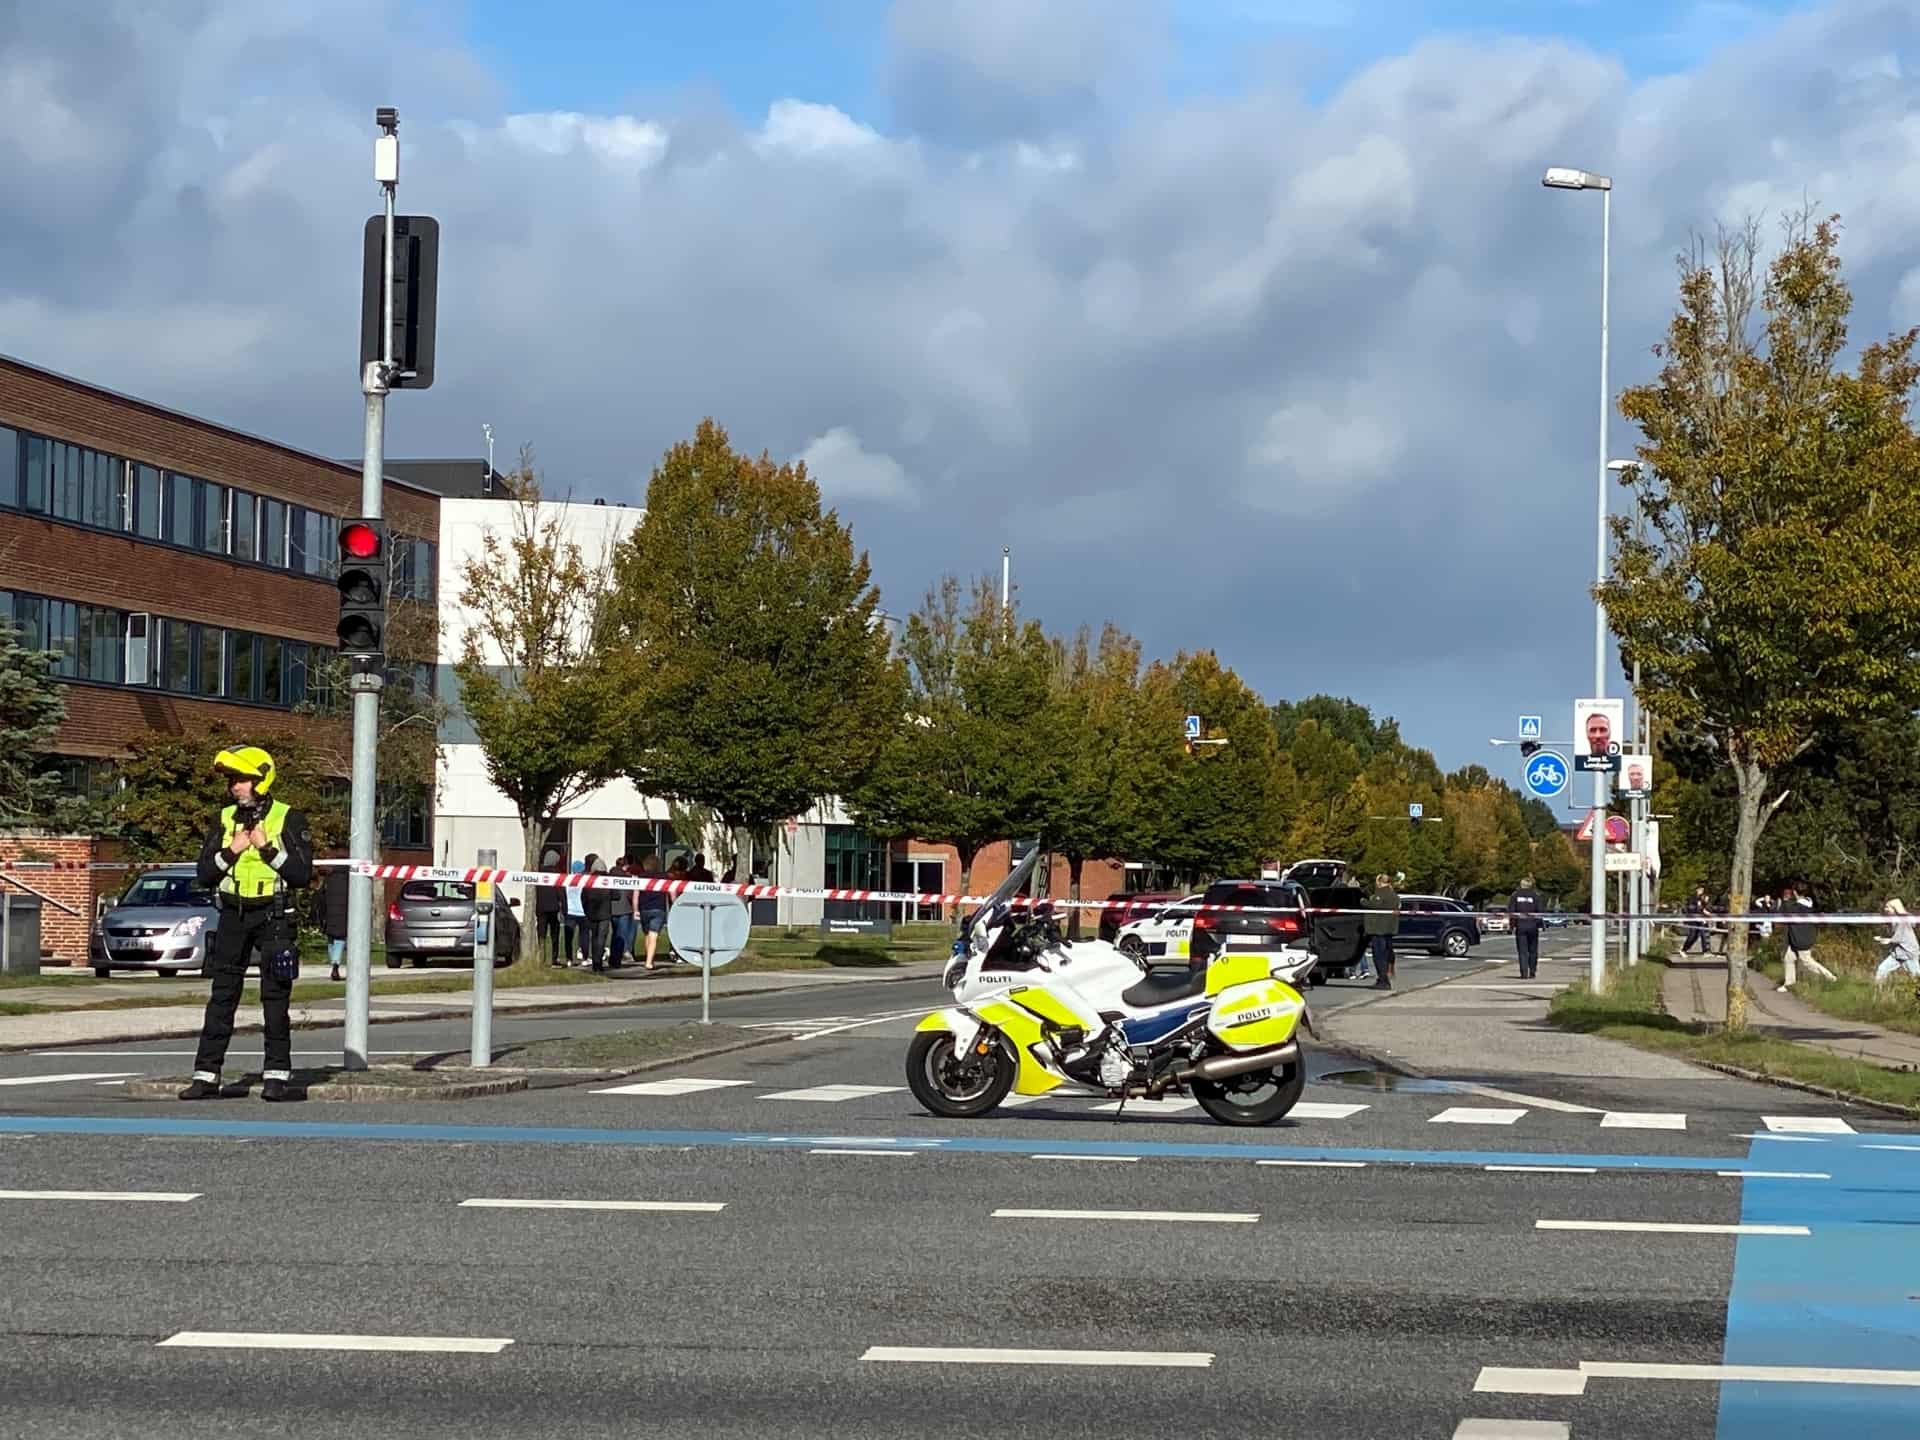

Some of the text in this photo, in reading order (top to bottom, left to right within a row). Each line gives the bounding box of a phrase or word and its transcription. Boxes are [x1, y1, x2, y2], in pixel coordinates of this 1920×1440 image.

[432, 869, 459, 877] POLITI
[512, 875, 539, 883] POLITI
[613, 878, 640, 886] POLITI
[694, 884, 721, 892] POLITI
[1165, 929, 1189, 938] POLITI
[979, 975, 1012, 983] POLITI
[1237, 1007, 1271, 1021] POLITI
